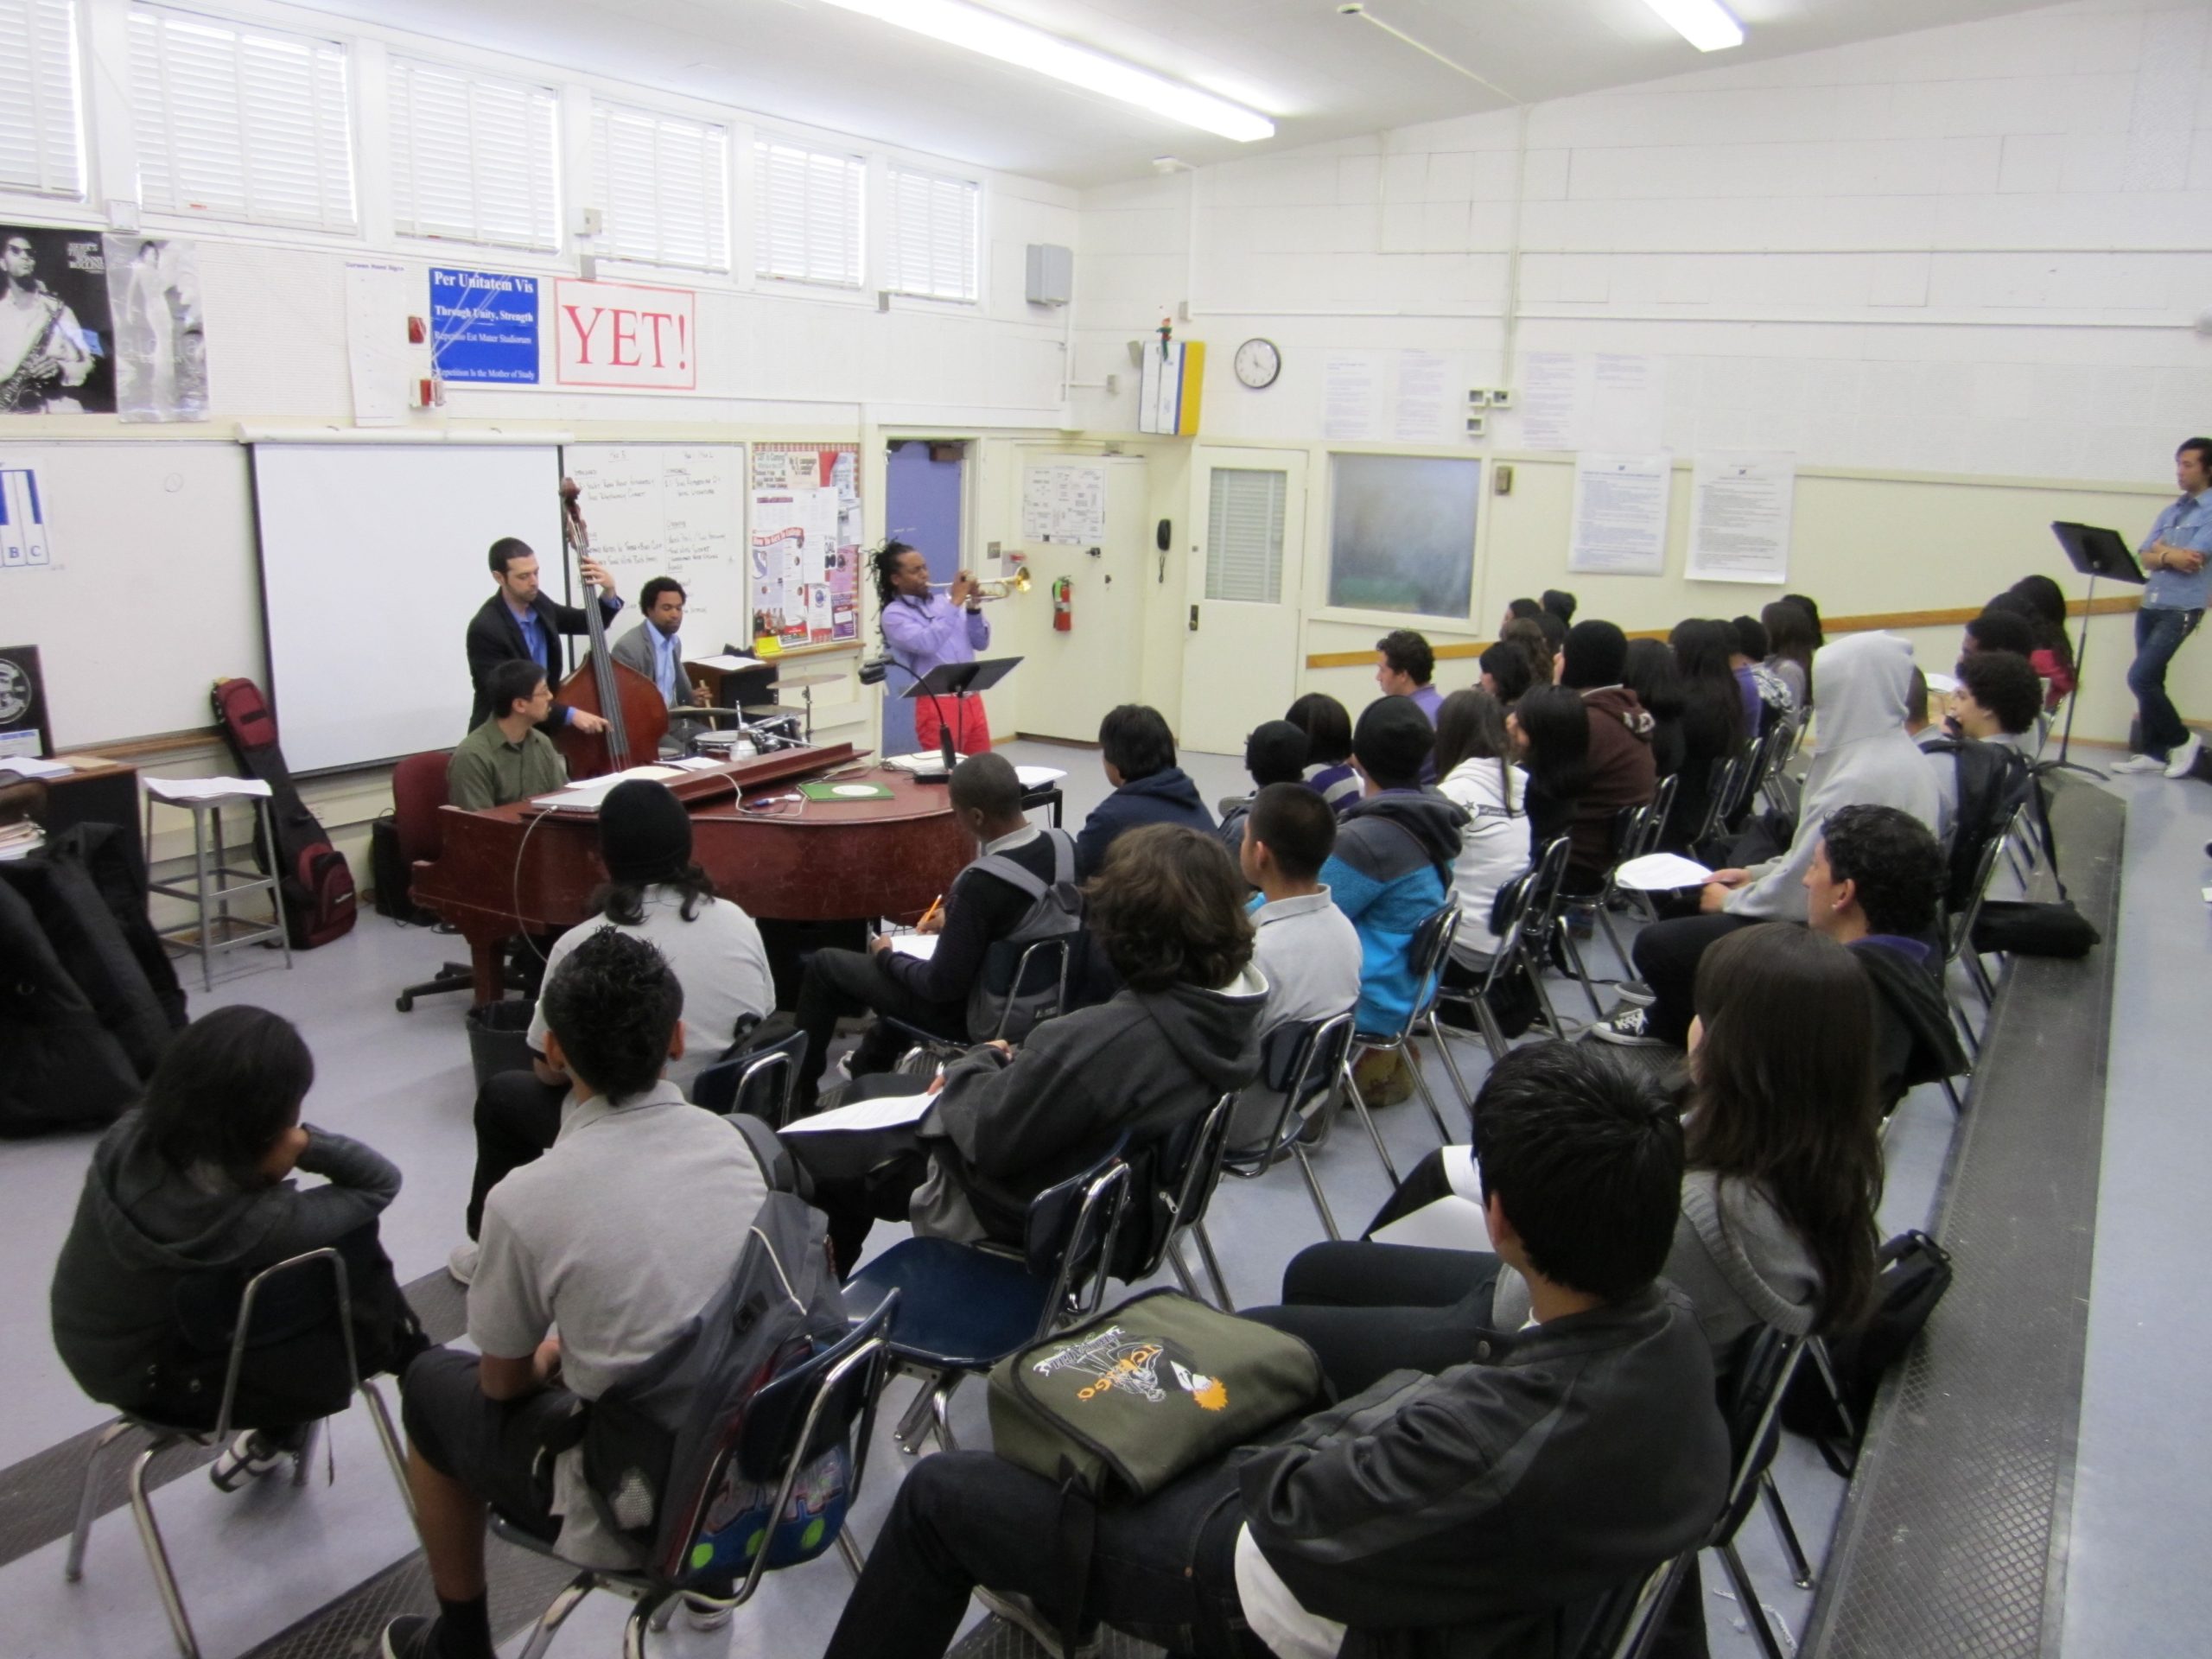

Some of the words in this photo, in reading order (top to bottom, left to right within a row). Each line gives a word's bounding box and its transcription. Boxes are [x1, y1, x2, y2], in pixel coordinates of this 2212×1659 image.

[434, 270, 456, 286] Per
[458, 273, 512, 291] Unitatem
[515, 278, 534, 293] Vis
[434, 305, 472, 320] Through
[473, 308, 499, 321] Unity,
[499, 309, 534, 323] Strength
[467, 332, 478, 341] Est
[479, 333, 499, 343] Mater
[499, 334, 531, 344] Studiorum
[562, 305, 686, 371] YET!
[438, 368, 469, 378] epetition
[487, 369, 510, 378] Mother
[518, 370, 535, 380] Study
[9, 547, 20, 558] B
[30, 545, 41, 556] C
